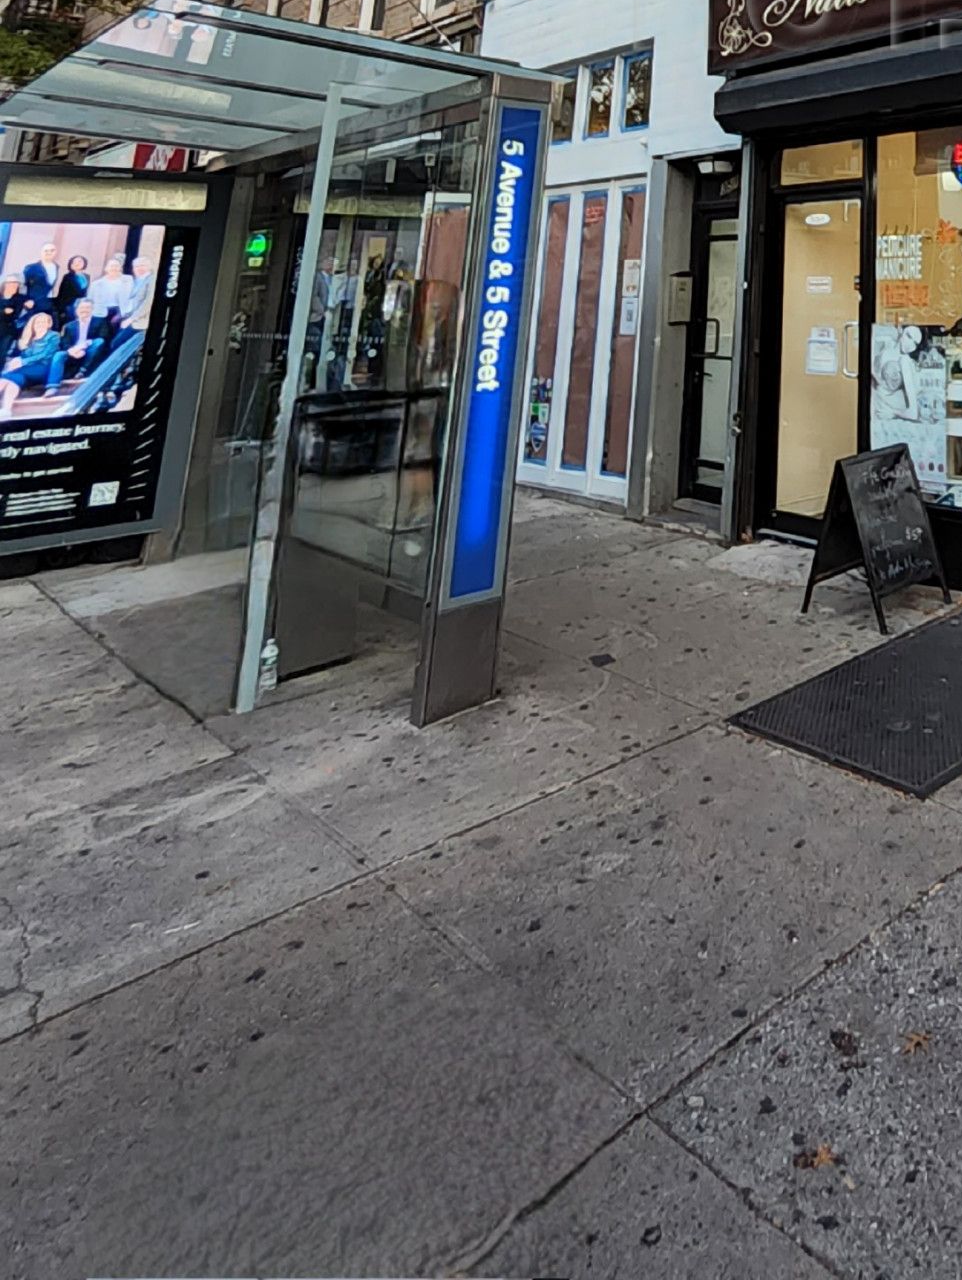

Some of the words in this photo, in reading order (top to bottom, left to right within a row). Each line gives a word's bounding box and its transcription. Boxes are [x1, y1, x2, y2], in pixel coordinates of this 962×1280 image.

[502, 139, 525, 157] 5
[491, 160, 523, 254] Avenue
[165, 244, 185, 298] COMPASS
[488, 259, 514, 280] &
[486, 285, 511, 304] 5
[476, 309, 508, 393] Street
[32, 428, 72, 439] estate
